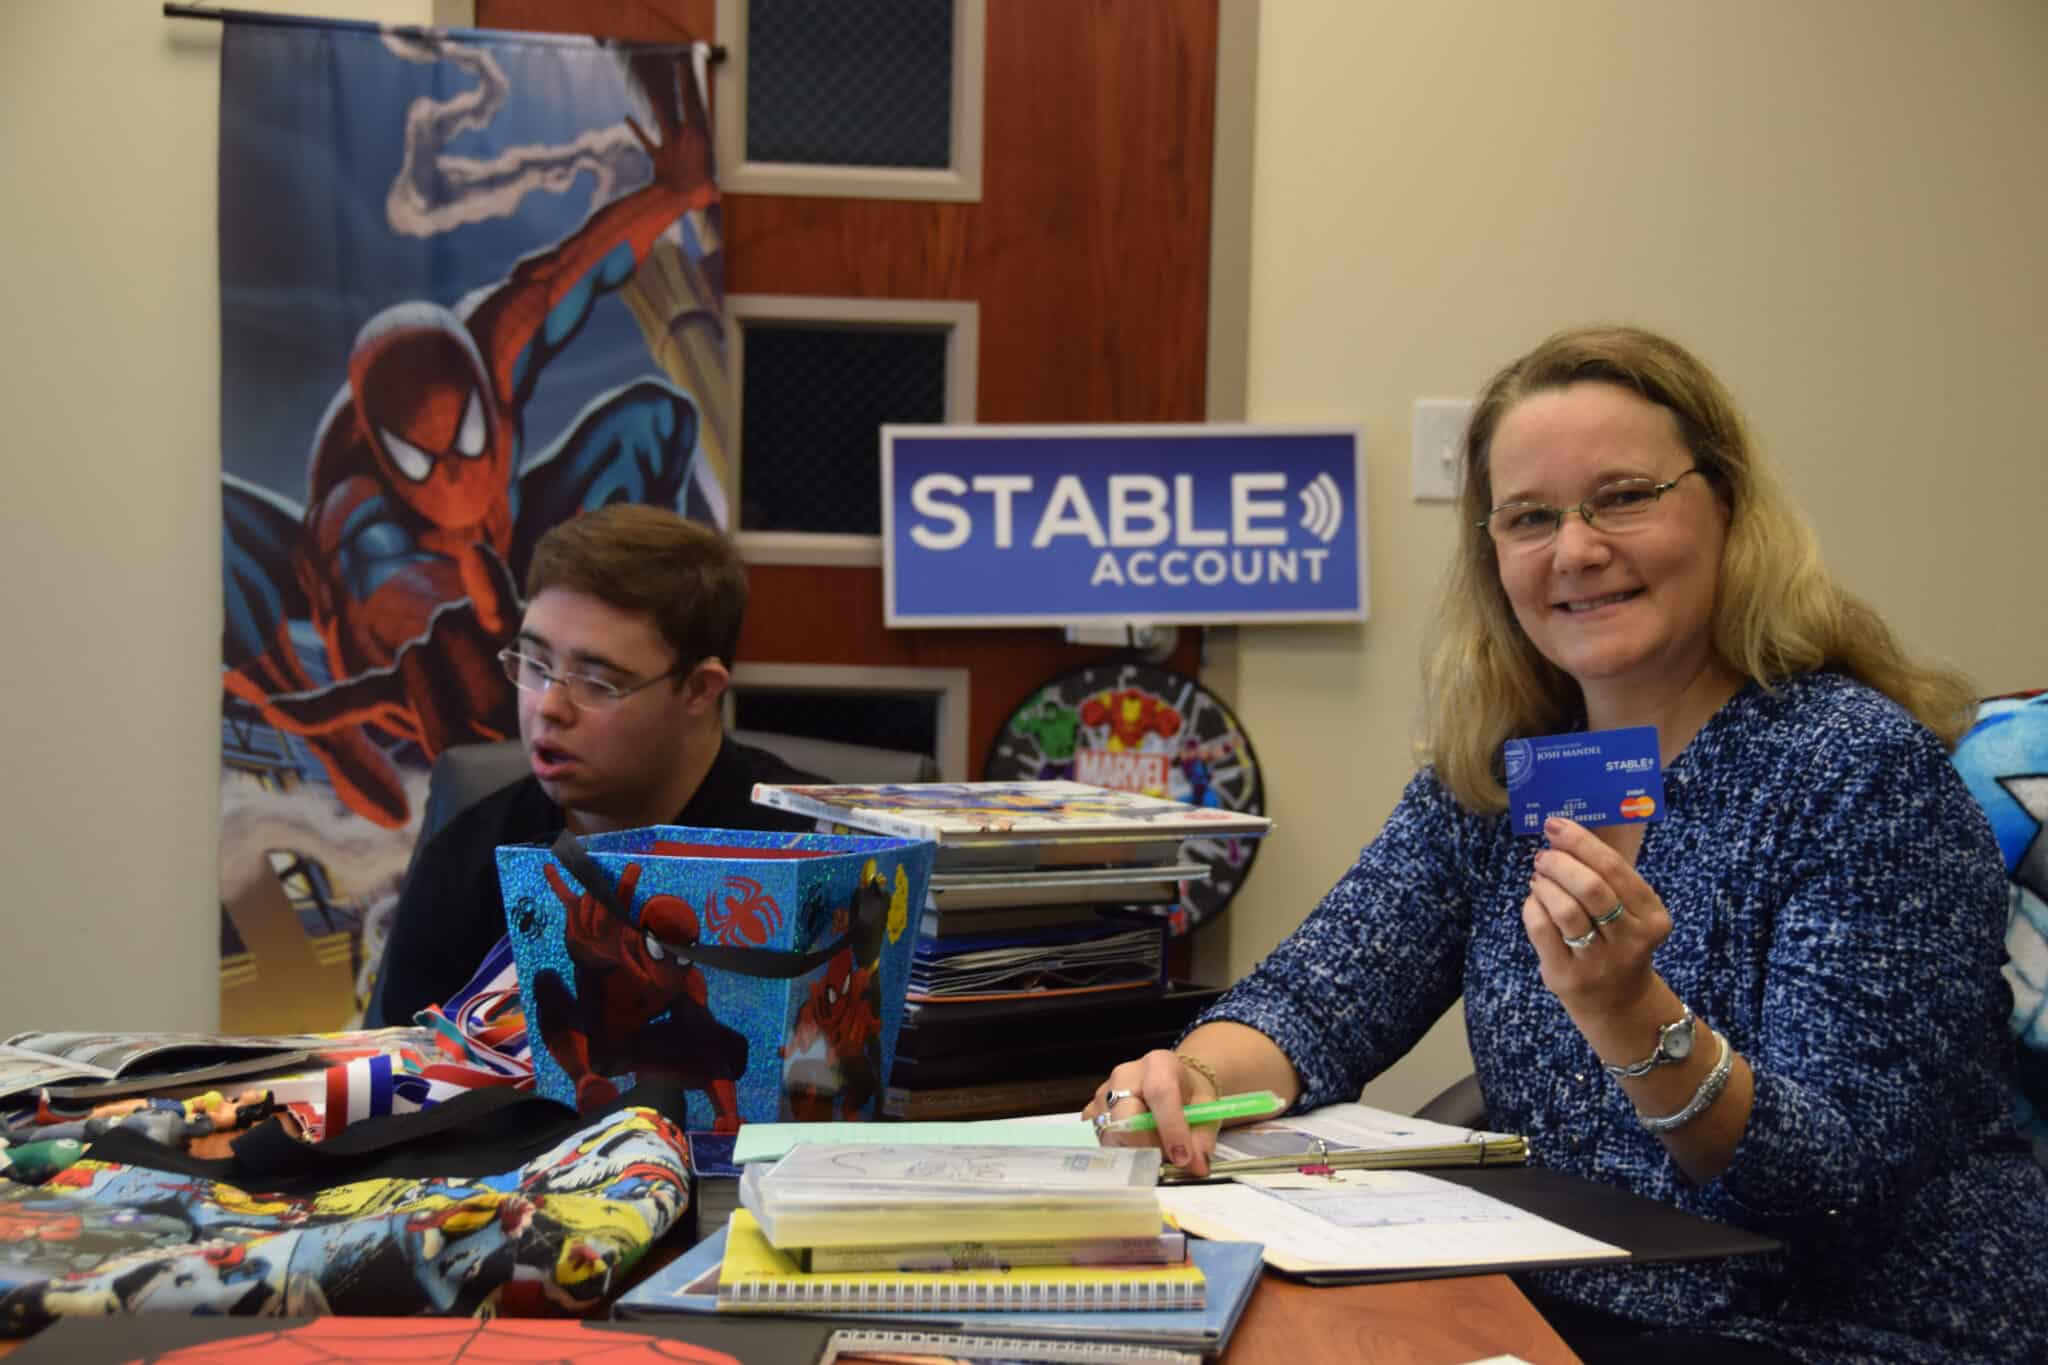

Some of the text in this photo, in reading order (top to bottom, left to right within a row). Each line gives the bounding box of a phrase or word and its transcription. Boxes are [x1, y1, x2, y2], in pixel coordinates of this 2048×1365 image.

[910, 472, 1288, 549] STABLE
[1090, 549, 1329, 586] ACCOUNT
[1079, 753, 1162, 790] MARVEL
[1537, 750, 1560, 761] JOSH
[1605, 758, 1648, 771] STABLE
